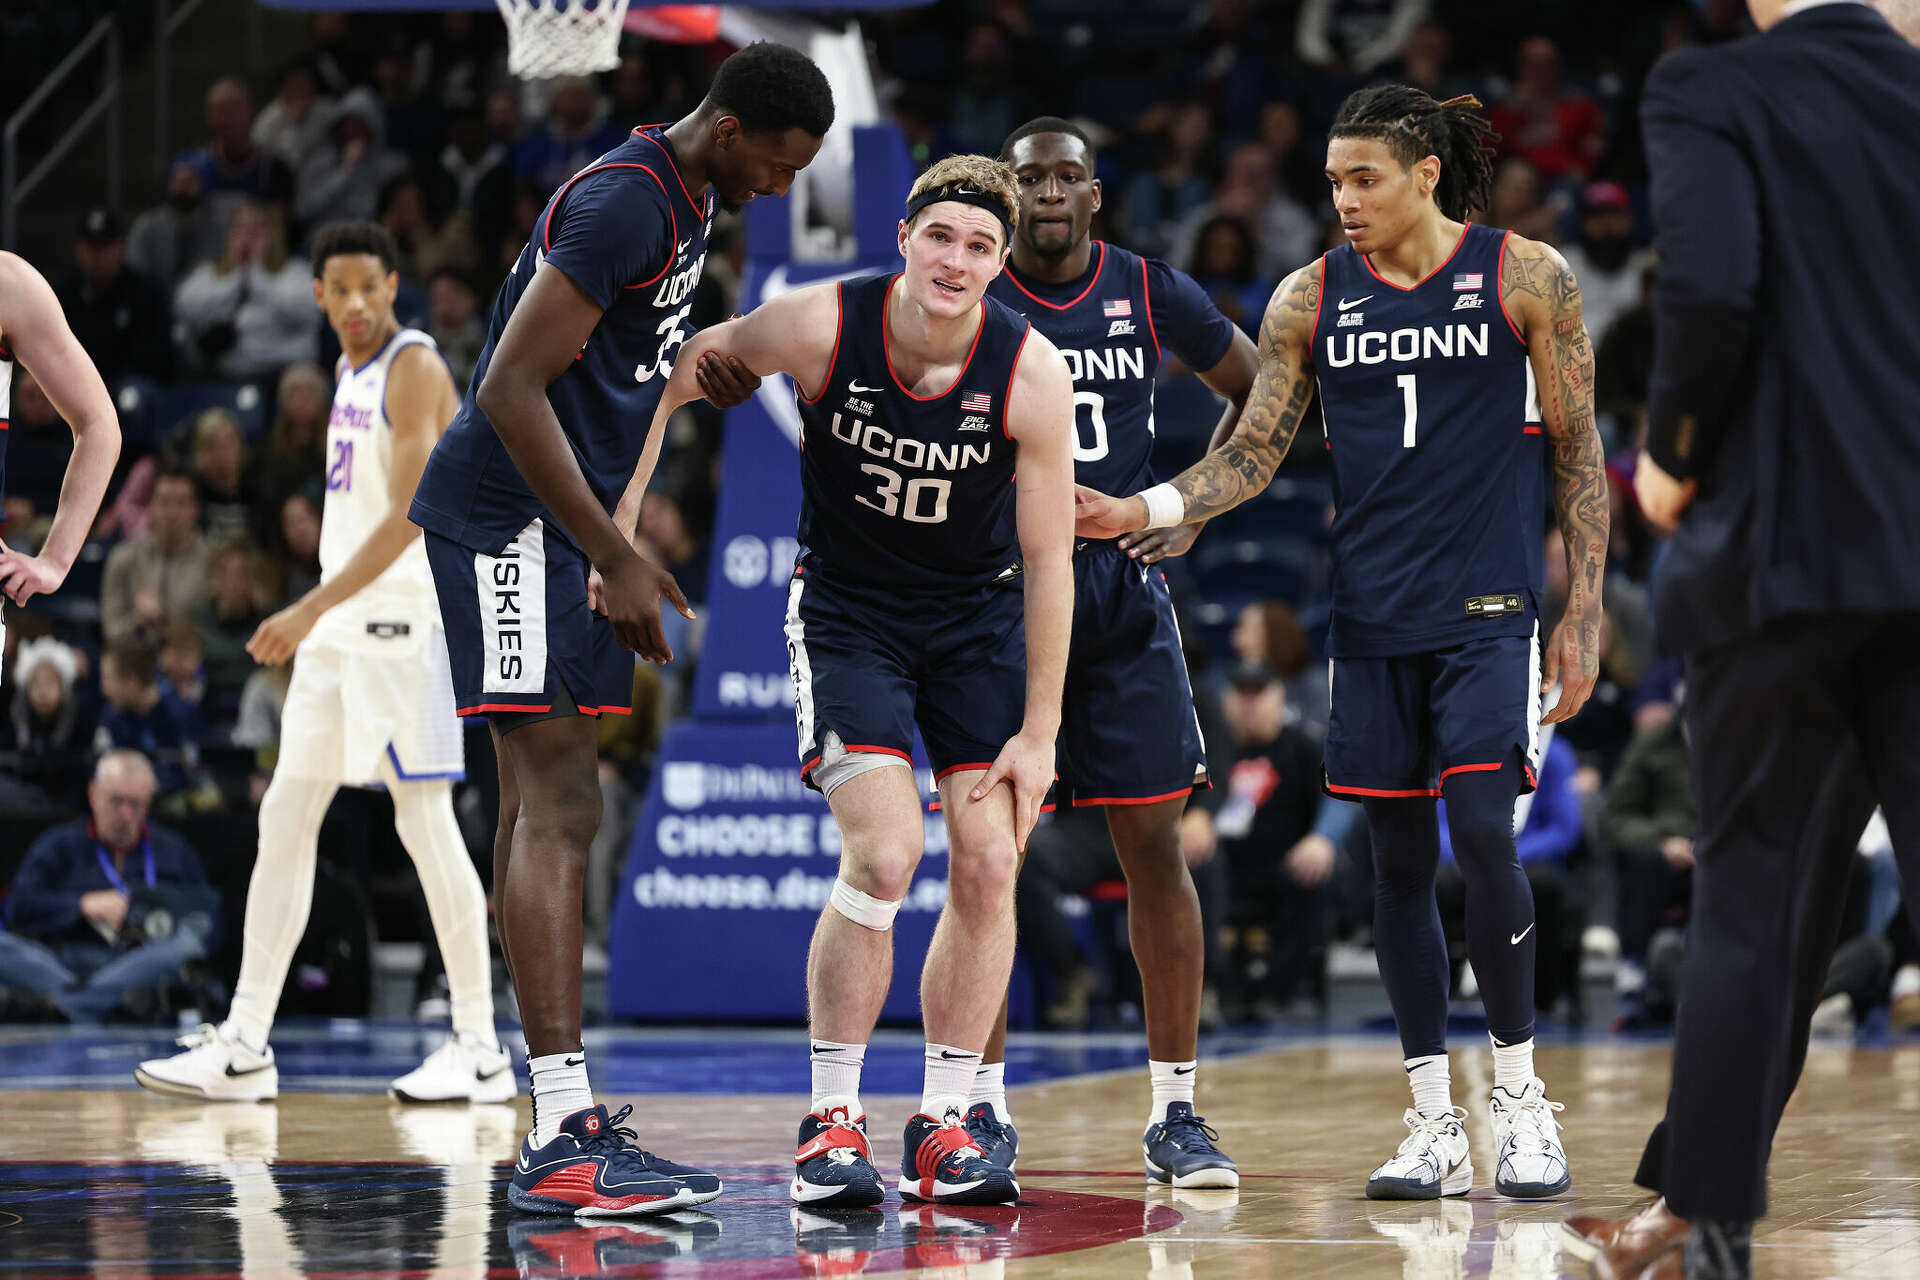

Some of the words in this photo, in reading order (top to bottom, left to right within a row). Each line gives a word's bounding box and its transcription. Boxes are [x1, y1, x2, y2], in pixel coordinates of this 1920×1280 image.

[1455, 299, 1484, 307] EAST
[1111, 319, 1131, 328] BIG
[1337, 318, 1364, 327] CHANGE
[1350, 312, 1364, 320] THE
[1108, 325, 1136, 334] EAST
[634, 303, 692, 382] 35
[1326, 323, 1489, 368] UCONN
[1058, 346, 1144, 381] ONN
[844, 402, 873, 417] CHANGE
[848, 396, 859, 405] BE
[860, 400, 874, 411] THE
[1396, 374, 1418, 448] 1
[960, 422, 991, 430] EAST
[964, 415, 986, 424] BIG
[832, 411, 991, 471] UCONN
[328, 440, 353, 492] 21
[855, 463, 952, 524] 30
[656, 813, 816, 858] CHOOSE
